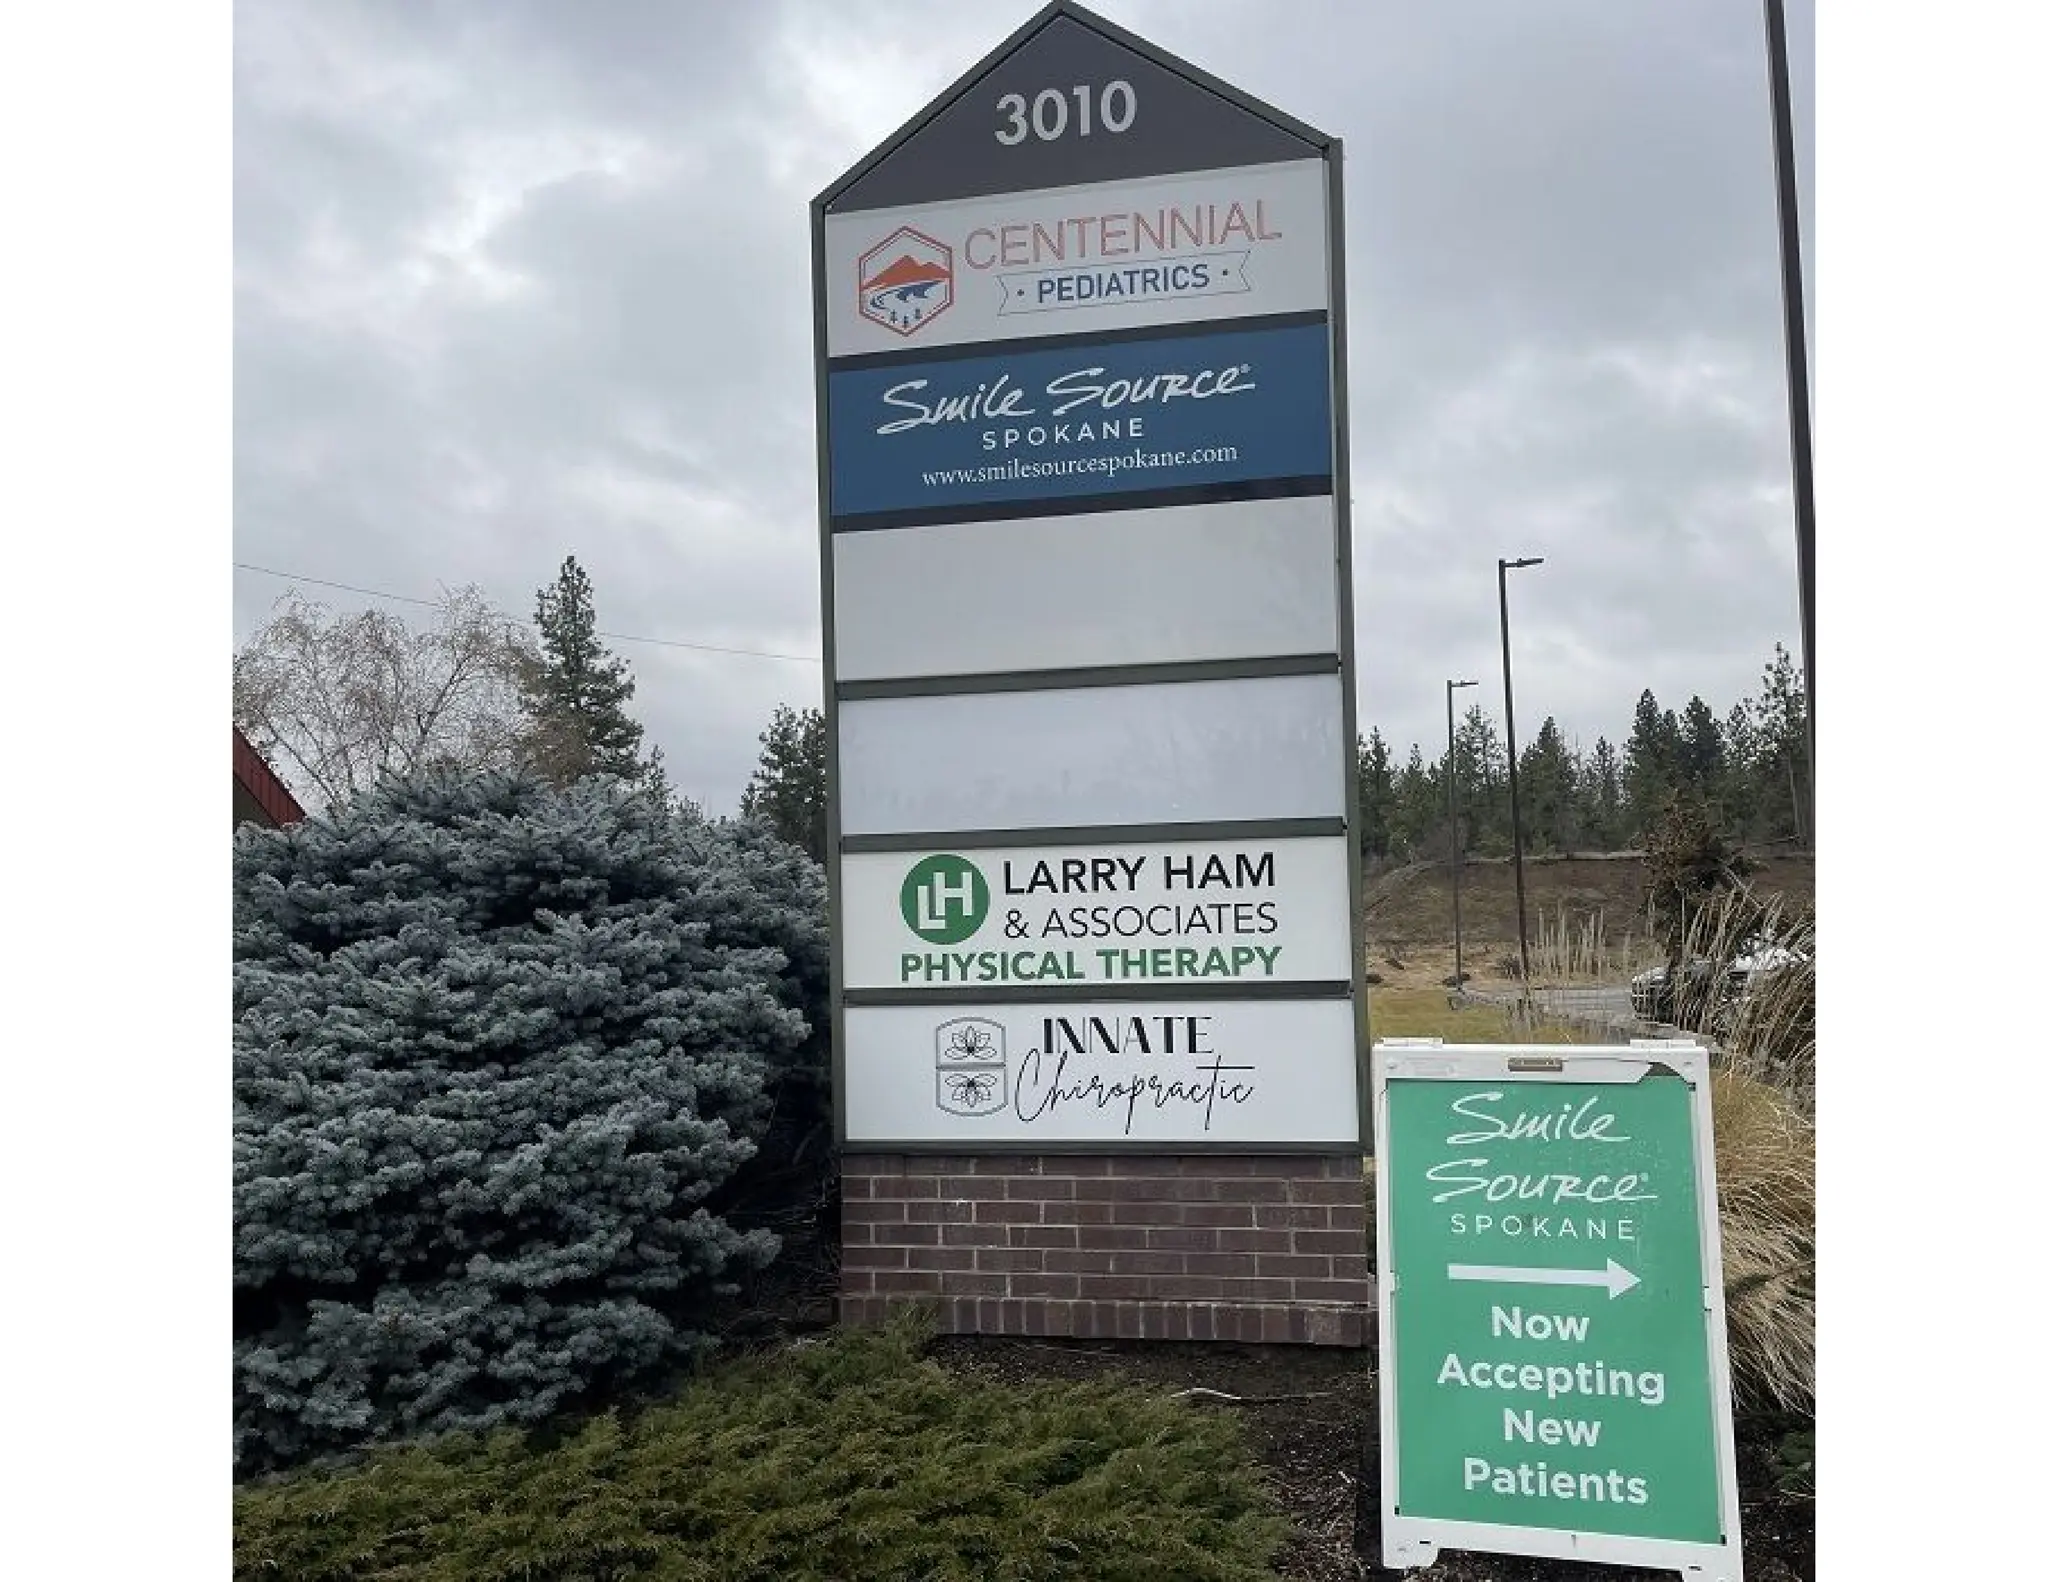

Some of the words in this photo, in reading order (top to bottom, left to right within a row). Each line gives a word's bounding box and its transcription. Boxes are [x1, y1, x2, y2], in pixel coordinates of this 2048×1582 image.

[995, 80, 1138, 145] 3010
[964, 199, 1283, 270] CENTENNIAL
[1037, 264, 1210, 303] PEDIATRICS
[876, 374, 1034, 435] Smile
[982, 418, 1145, 450] SPOKANE
[922, 443, 1238, 487] www.smilesourcespokane.com
[1004, 856, 1146, 894] LARRY
[1165, 852, 1276, 889] HAM
[1004, 910, 1029, 938] &
[1042, 902, 1279, 937] ASSOCIATES
[901, 950, 1085, 981] PHYSICAL
[1096, 946, 1282, 978] THERAPY
[1043, 1016, 1214, 1054] INNATE
[1014, 1048, 1255, 1134] Chiropractic
[1446, 1091, 1630, 1144] Smile
[1451, 1214, 1636, 1240] SPOKANE
[1491, 1306, 1590, 1341] Now
[1437, 1353, 1665, 1405] Accepting
[1504, 1408, 1602, 1447] New
[1464, 1457, 1649, 1505] Patients
